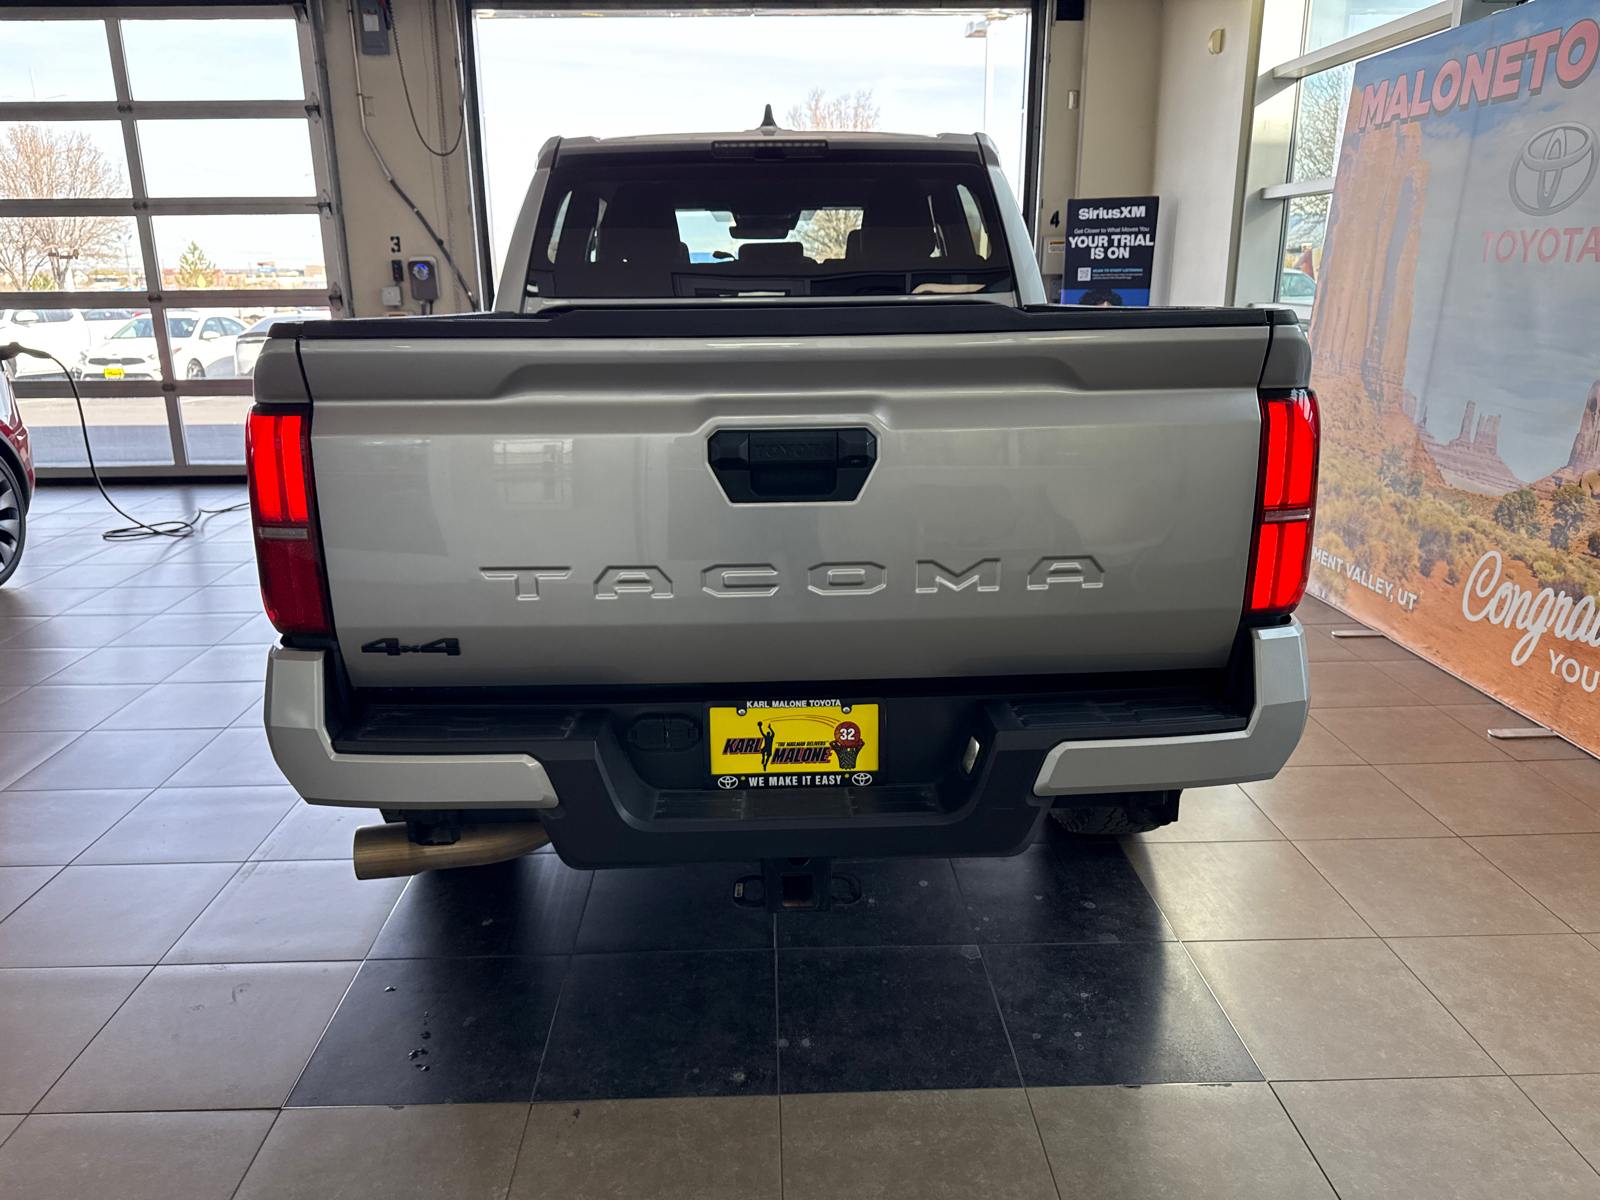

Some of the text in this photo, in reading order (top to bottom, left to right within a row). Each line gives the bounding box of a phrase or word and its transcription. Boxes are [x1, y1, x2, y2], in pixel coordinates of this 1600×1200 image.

[1050, 210, 1060, 228] 4
[1078, 205, 1146, 220] SiriusXM
[390, 236, 402, 253] 3
[1068, 235, 1108, 249] YOUR
[1111, 233, 1154, 247] TRIAL
[1482, 226, 1600, 264] TOYOTA
[1090, 246, 1130, 260] IS ON
[752, 443, 834, 459] TOYOTA
[478, 555, 1105, 601] TACOMA
[1346, 562, 1394, 603] VALLEY,
[1397, 587, 1418, 610] UT
[1549, 648, 1600, 693] YOU
[746, 699, 842, 708] KARL MALONE TOYOTA
[839, 727, 856, 741] 32
[722, 738, 763, 755] KARL
[771, 746, 833, 765] MALONE
[748, 774, 842, 787] WE MAKE IT EASY
